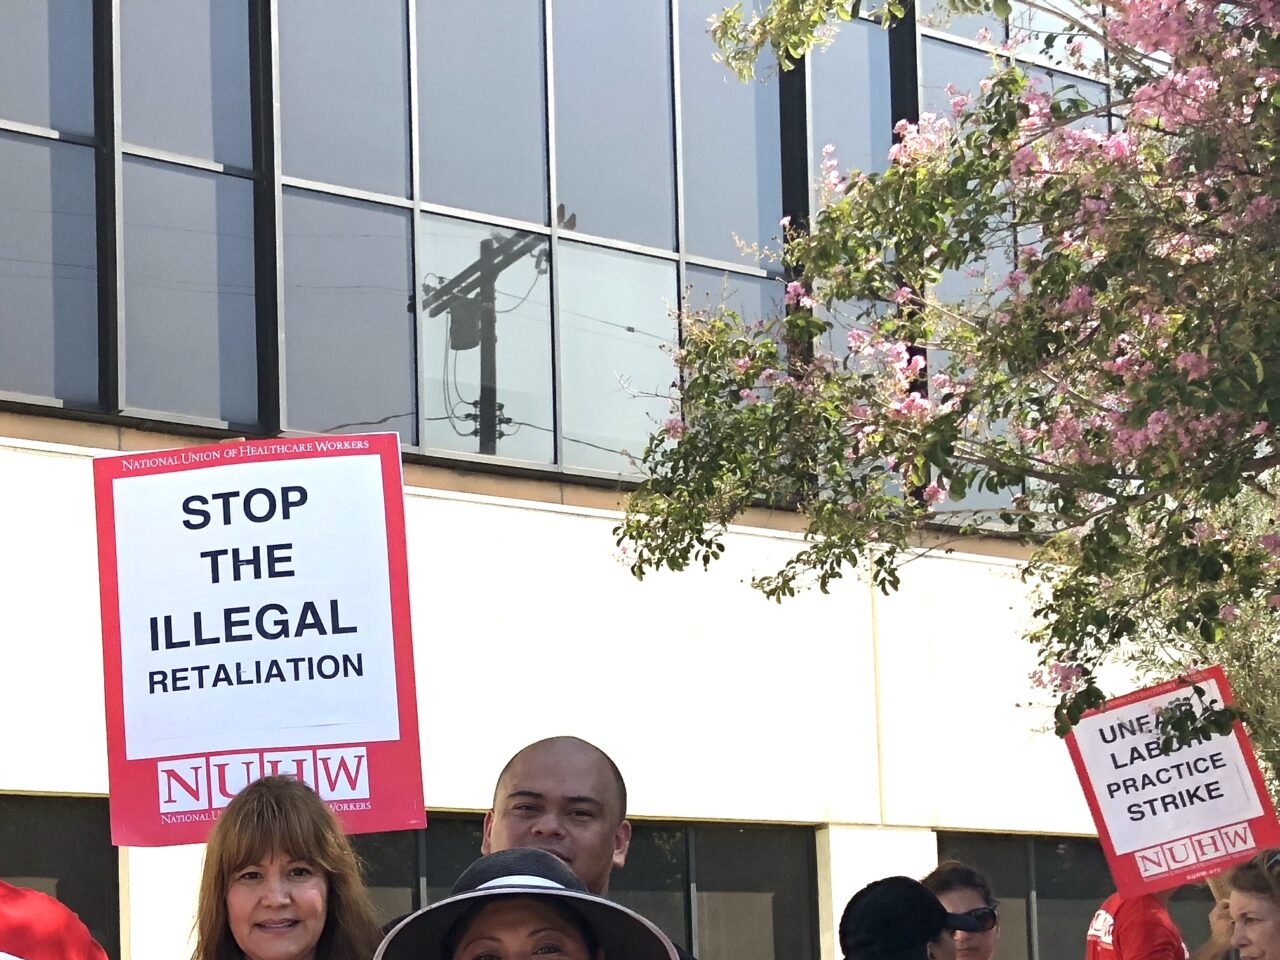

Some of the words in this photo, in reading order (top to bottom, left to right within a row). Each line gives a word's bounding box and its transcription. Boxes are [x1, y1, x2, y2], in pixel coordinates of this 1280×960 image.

[122, 455, 180, 471] NATIONAL
[181, 450, 221, 464] UNION
[223, 448, 238, 458] OF
[239, 443, 314, 457] HEALTHCARE
[315, 440, 370, 452] WORKERS
[181, 485, 308, 531] STOP
[200, 542, 295, 584] THE
[149, 598, 358, 652] ILLEGAL
[148, 653, 364, 695] RETALIATION
[1106, 752, 1227, 799] PRACTICE
[161, 813, 210, 825] NATIONAL
[1126, 780, 1225, 822] STRIKE
[1138, 826, 1250, 873] NUHW
